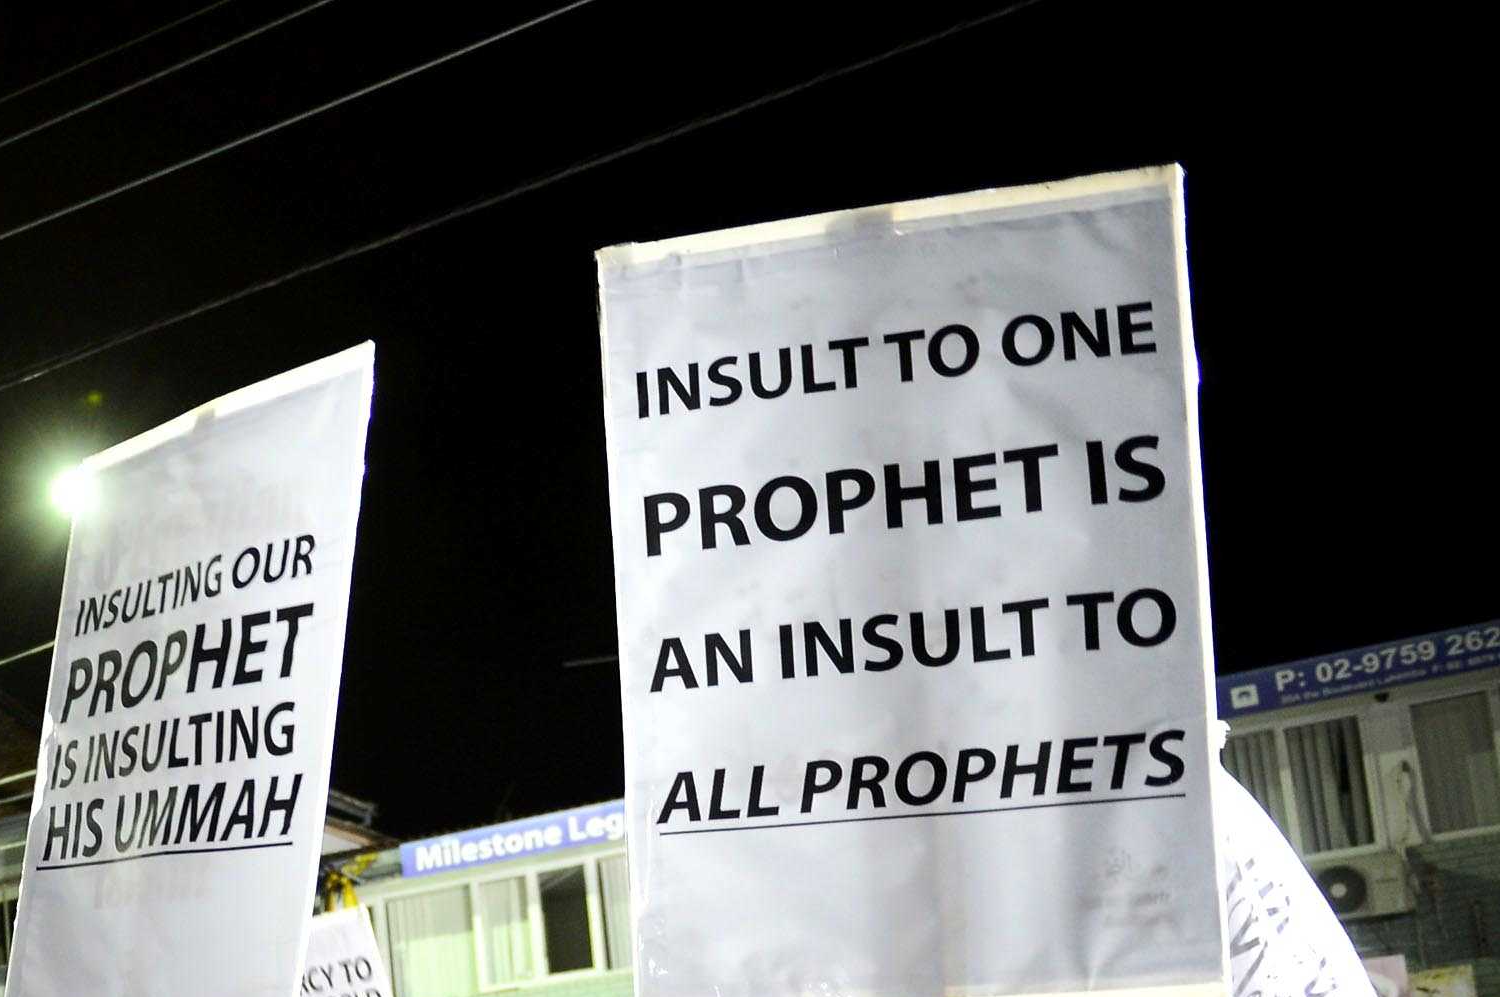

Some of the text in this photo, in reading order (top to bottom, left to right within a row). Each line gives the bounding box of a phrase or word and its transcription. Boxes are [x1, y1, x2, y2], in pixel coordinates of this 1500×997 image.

[636, 301, 1158, 419] INSULT TO ONE
[643, 434, 1167, 557] PROPHET IS
[75, 533, 316, 637] INSULTING OUR
[61, 603, 314, 724] PROPHET
[649, 587, 1177, 693] AN INSULT TO
[1315, 640, 1436, 684] 02-9759
[50, 702, 295, 790] IS INSULTING
[656, 729, 1186, 824] ALL PROPHETS
[43, 773, 303, 862] HIS UMMAH
[415, 824, 562, 872] Milestone
[338, 956, 372, 985] TO
